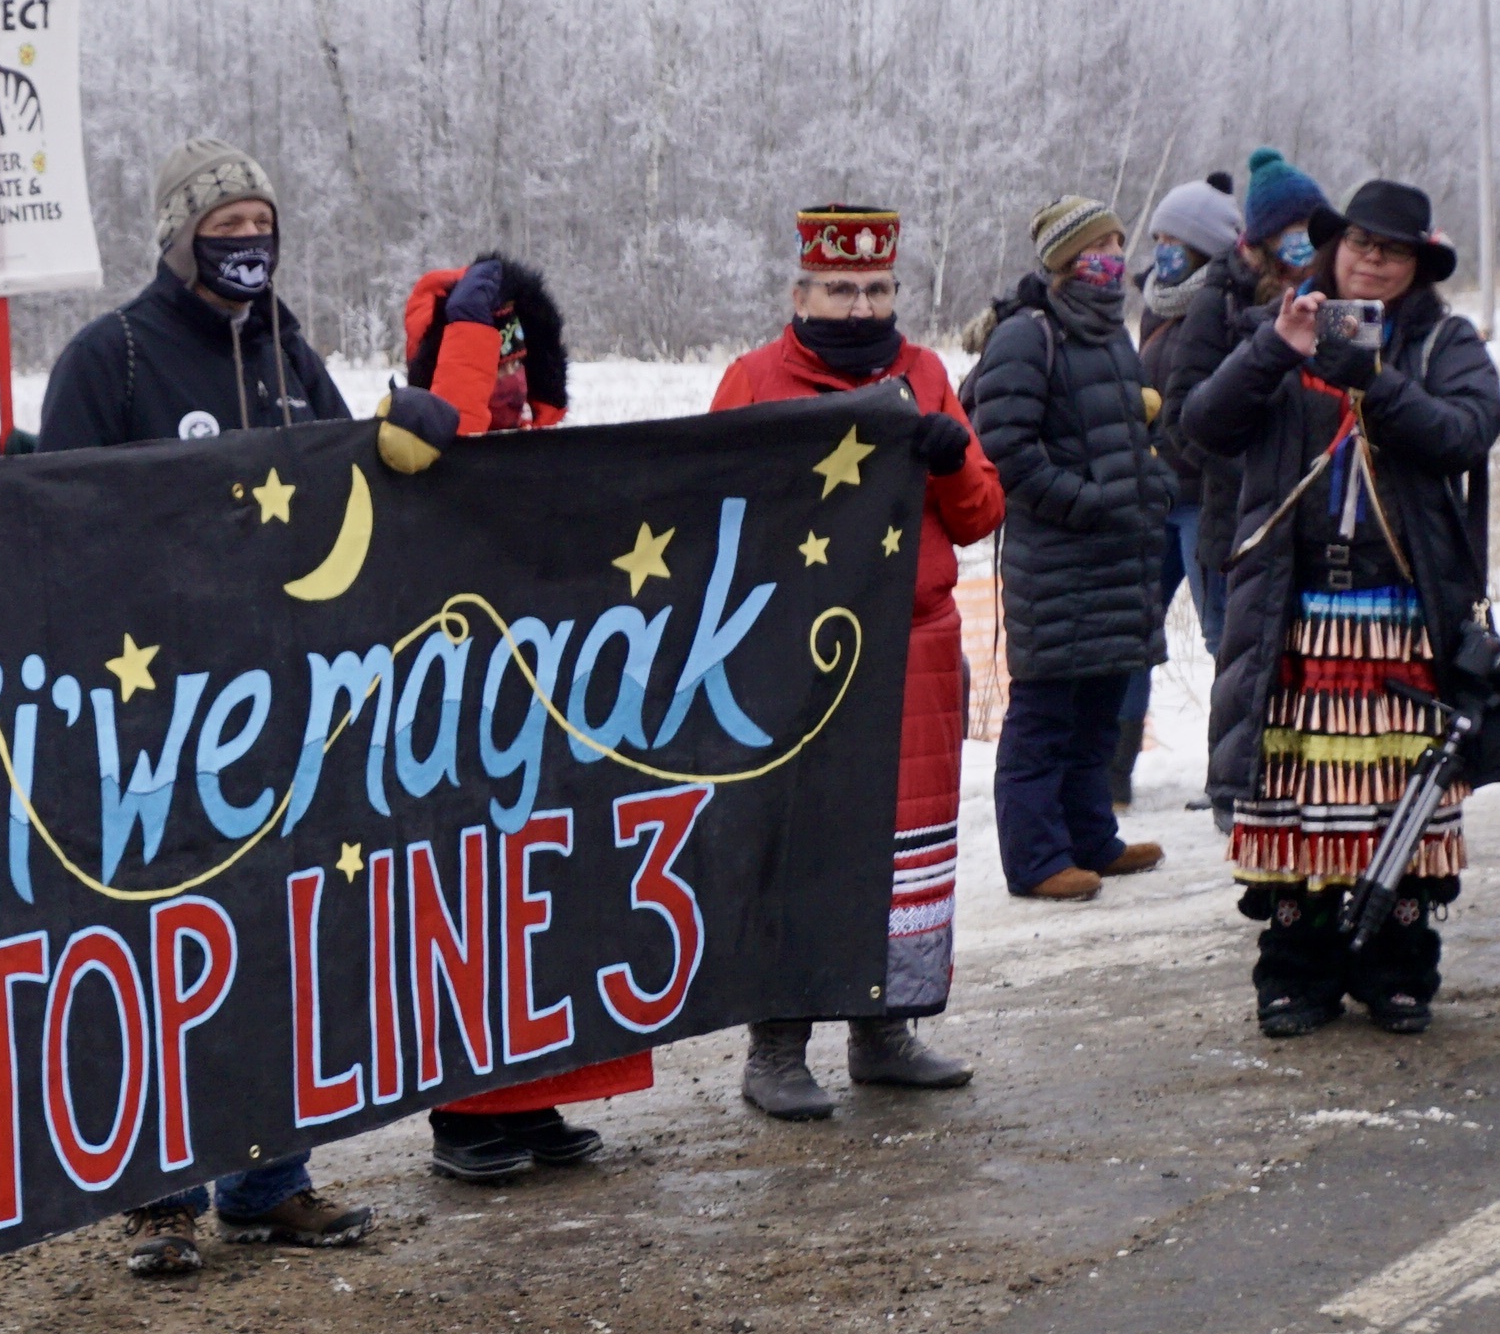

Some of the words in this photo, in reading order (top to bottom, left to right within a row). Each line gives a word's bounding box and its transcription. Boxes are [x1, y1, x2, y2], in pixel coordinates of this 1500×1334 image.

[29, 177, 42, 195] &
[287, 809, 575, 1129] LINE
[597, 782, 706, 1033] 3
